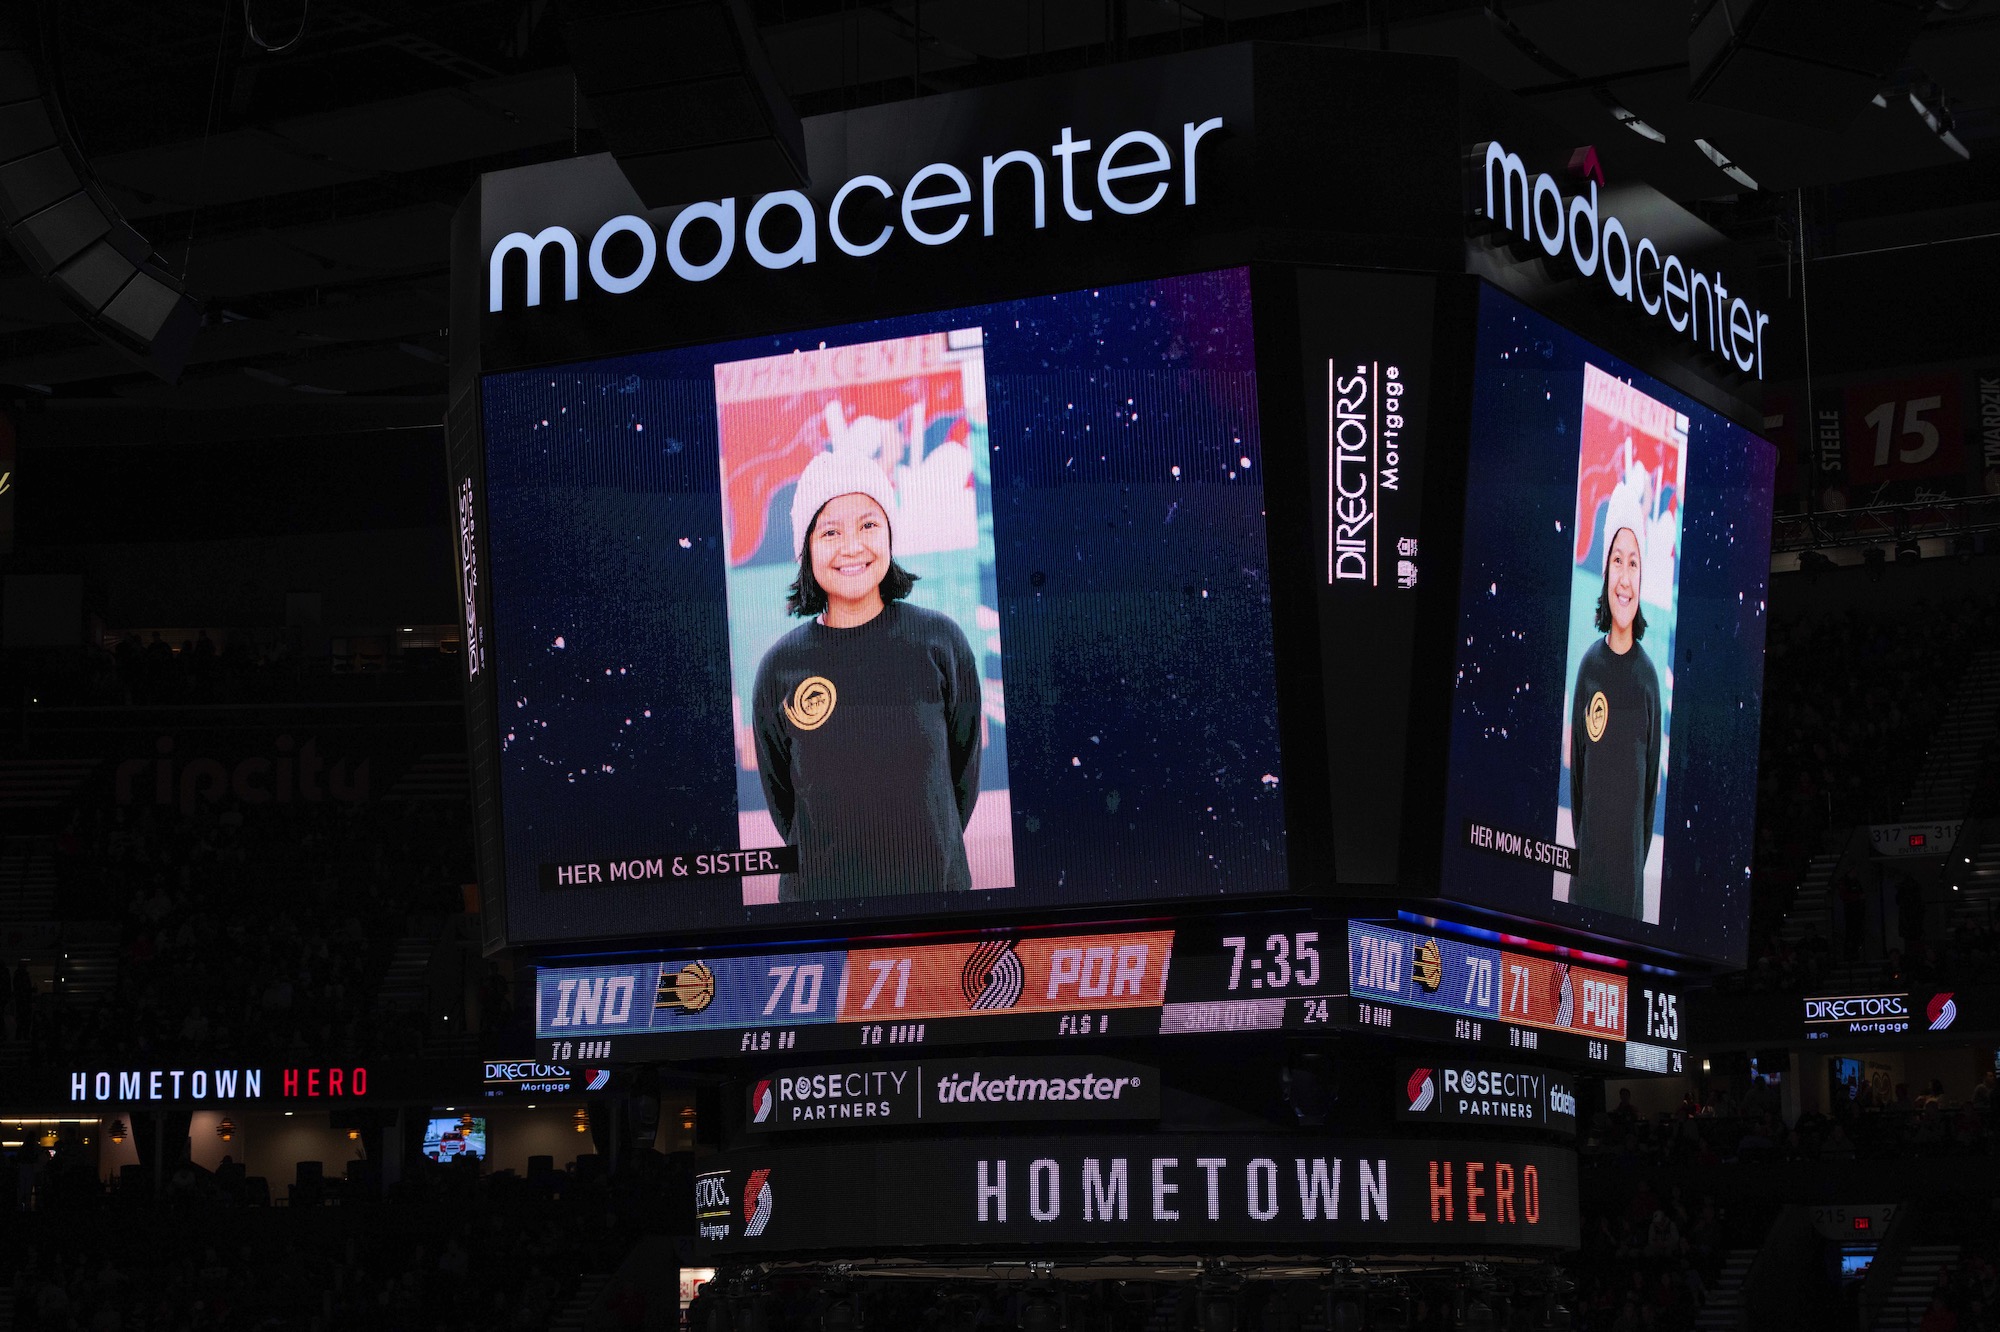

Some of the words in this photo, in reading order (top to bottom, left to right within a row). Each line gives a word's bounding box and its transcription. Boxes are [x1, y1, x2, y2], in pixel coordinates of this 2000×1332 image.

[1380, 366, 1404, 491] Mortgage
[1819, 410, 1842, 471] STEELE
[1864, 395, 1942, 468] 15
[1470, 823, 1493, 849] HER
[1495, 830, 1522, 856] MOM
[1523, 838, 1533, 859] &
[1534, 841, 1571, 870] SISTER.
[1872, 828, 1901, 842] 317
[557, 863, 603, 886] HER
[609, 858, 664, 882] MOM
[671, 856, 689, 877] &
[695, 850, 780, 875] SISTER.
[1046, 944, 1149, 1000] POR
[1221, 932, 1319, 990] 7:35
[1357, 935, 1401, 992] IND
[1464, 956, 1492, 1007] 70
[550, 976, 635, 1027] IND
[762, 964, 824, 1015] 70
[863, 958, 912, 1009] 71
[1509, 965, 1529, 1014] 71
[1058, 1014, 1091, 1036] FLS
[1303, 999, 1329, 1023] 24
[1359, 1004, 1372, 1025] TO
[1582, 979, 1620, 1030] POR
[1643, 989, 1678, 1041] 7:35
[740, 1031, 771, 1051] FLS
[860, 1025, 882, 1045] TO
[1510, 1027, 1522, 1048] TO
[1850, 1022, 1909, 1034] Mortgage
[552, 1041, 572, 1061] TO
[1672, 1052, 1683, 1073] 24
[71, 1069, 261, 1101] HOMETOWN
[283, 1067, 368, 1097] HERO
[521, 1083, 571, 1093] Mortgage
[792, 1101, 891, 1121] PARTNERS
[1459, 1100, 1533, 1119] PARTNERS
[976, 1157, 1389, 1223] HOMETOWN
[1429, 1160, 1540, 1224] HERO
